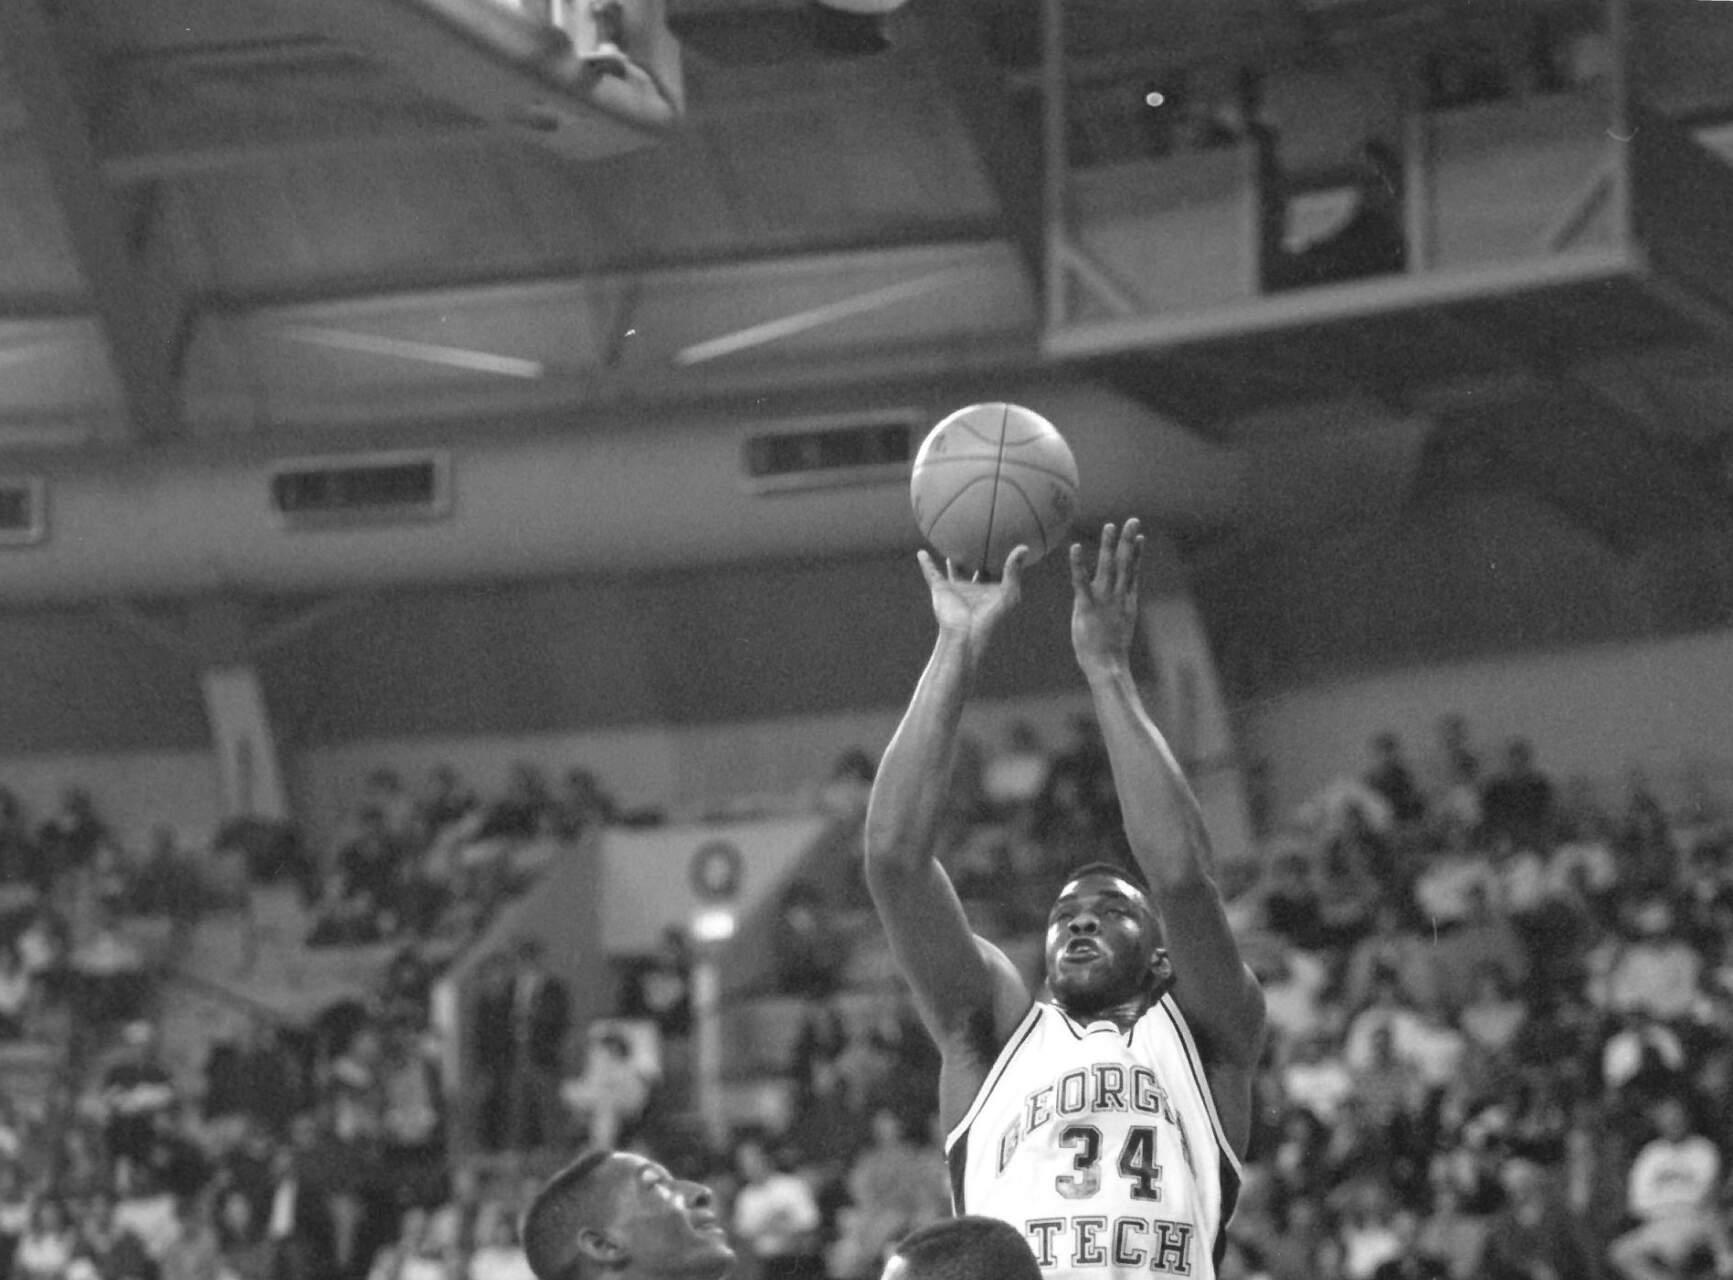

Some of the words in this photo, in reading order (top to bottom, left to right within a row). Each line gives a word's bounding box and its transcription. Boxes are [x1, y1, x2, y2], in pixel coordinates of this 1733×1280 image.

[996, 1063, 1196, 1180] GEORG
[1056, 1124, 1162, 1201] 34
[1026, 1215, 1194, 1277] TECH
